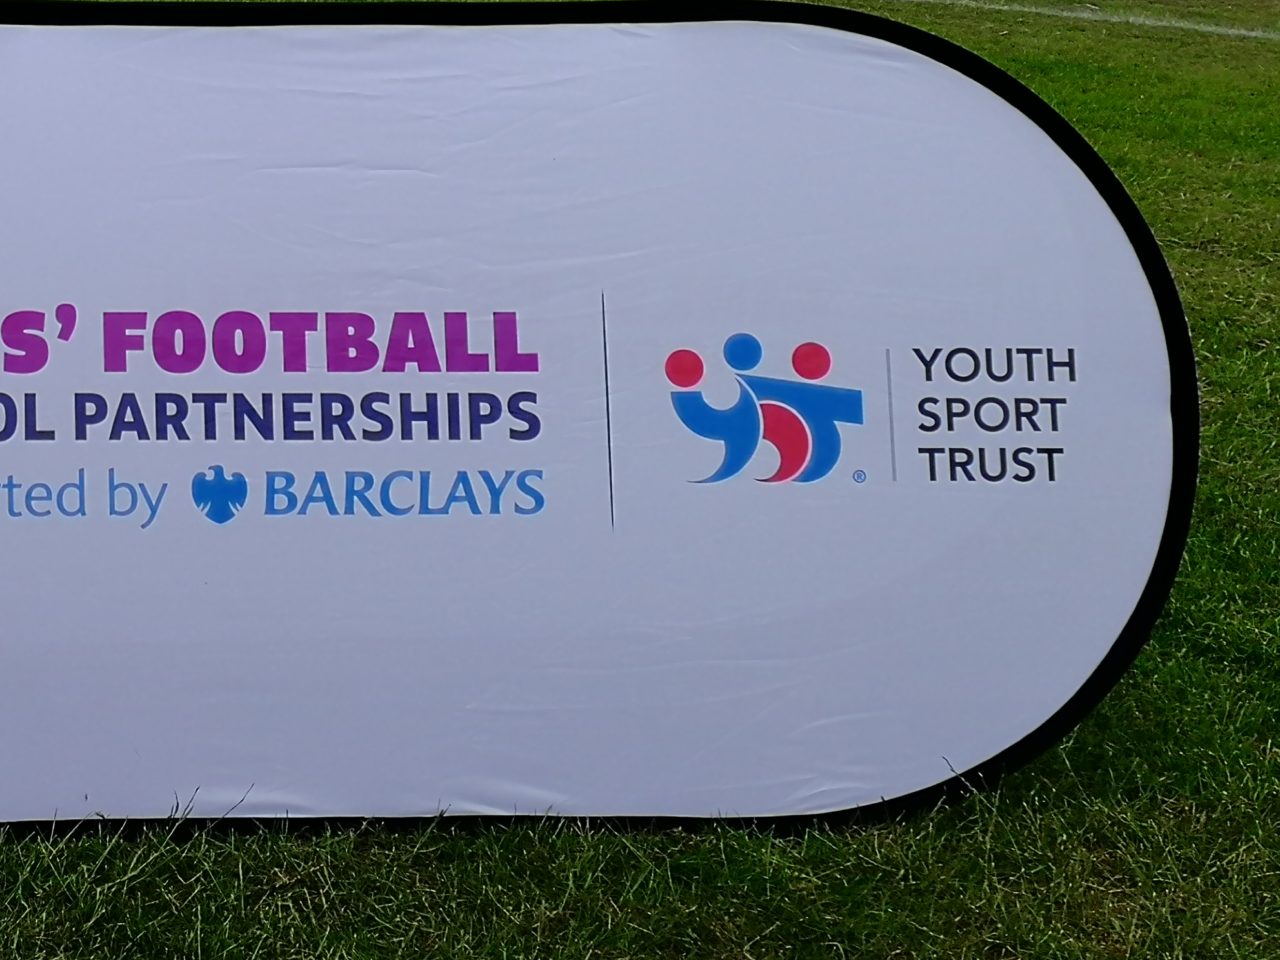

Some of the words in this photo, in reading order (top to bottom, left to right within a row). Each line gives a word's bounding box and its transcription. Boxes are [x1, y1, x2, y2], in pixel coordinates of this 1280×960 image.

[103, 310, 539, 374] FOOTBALL
[912, 347, 1076, 382] YOUTH
[75, 391, 541, 442] PARTNERSHIPS
[917, 397, 1067, 432] SPORT
[918, 447, 1064, 482] TRUST
[108, 467, 168, 529] by
[264, 469, 545, 516] BARCLAYS
